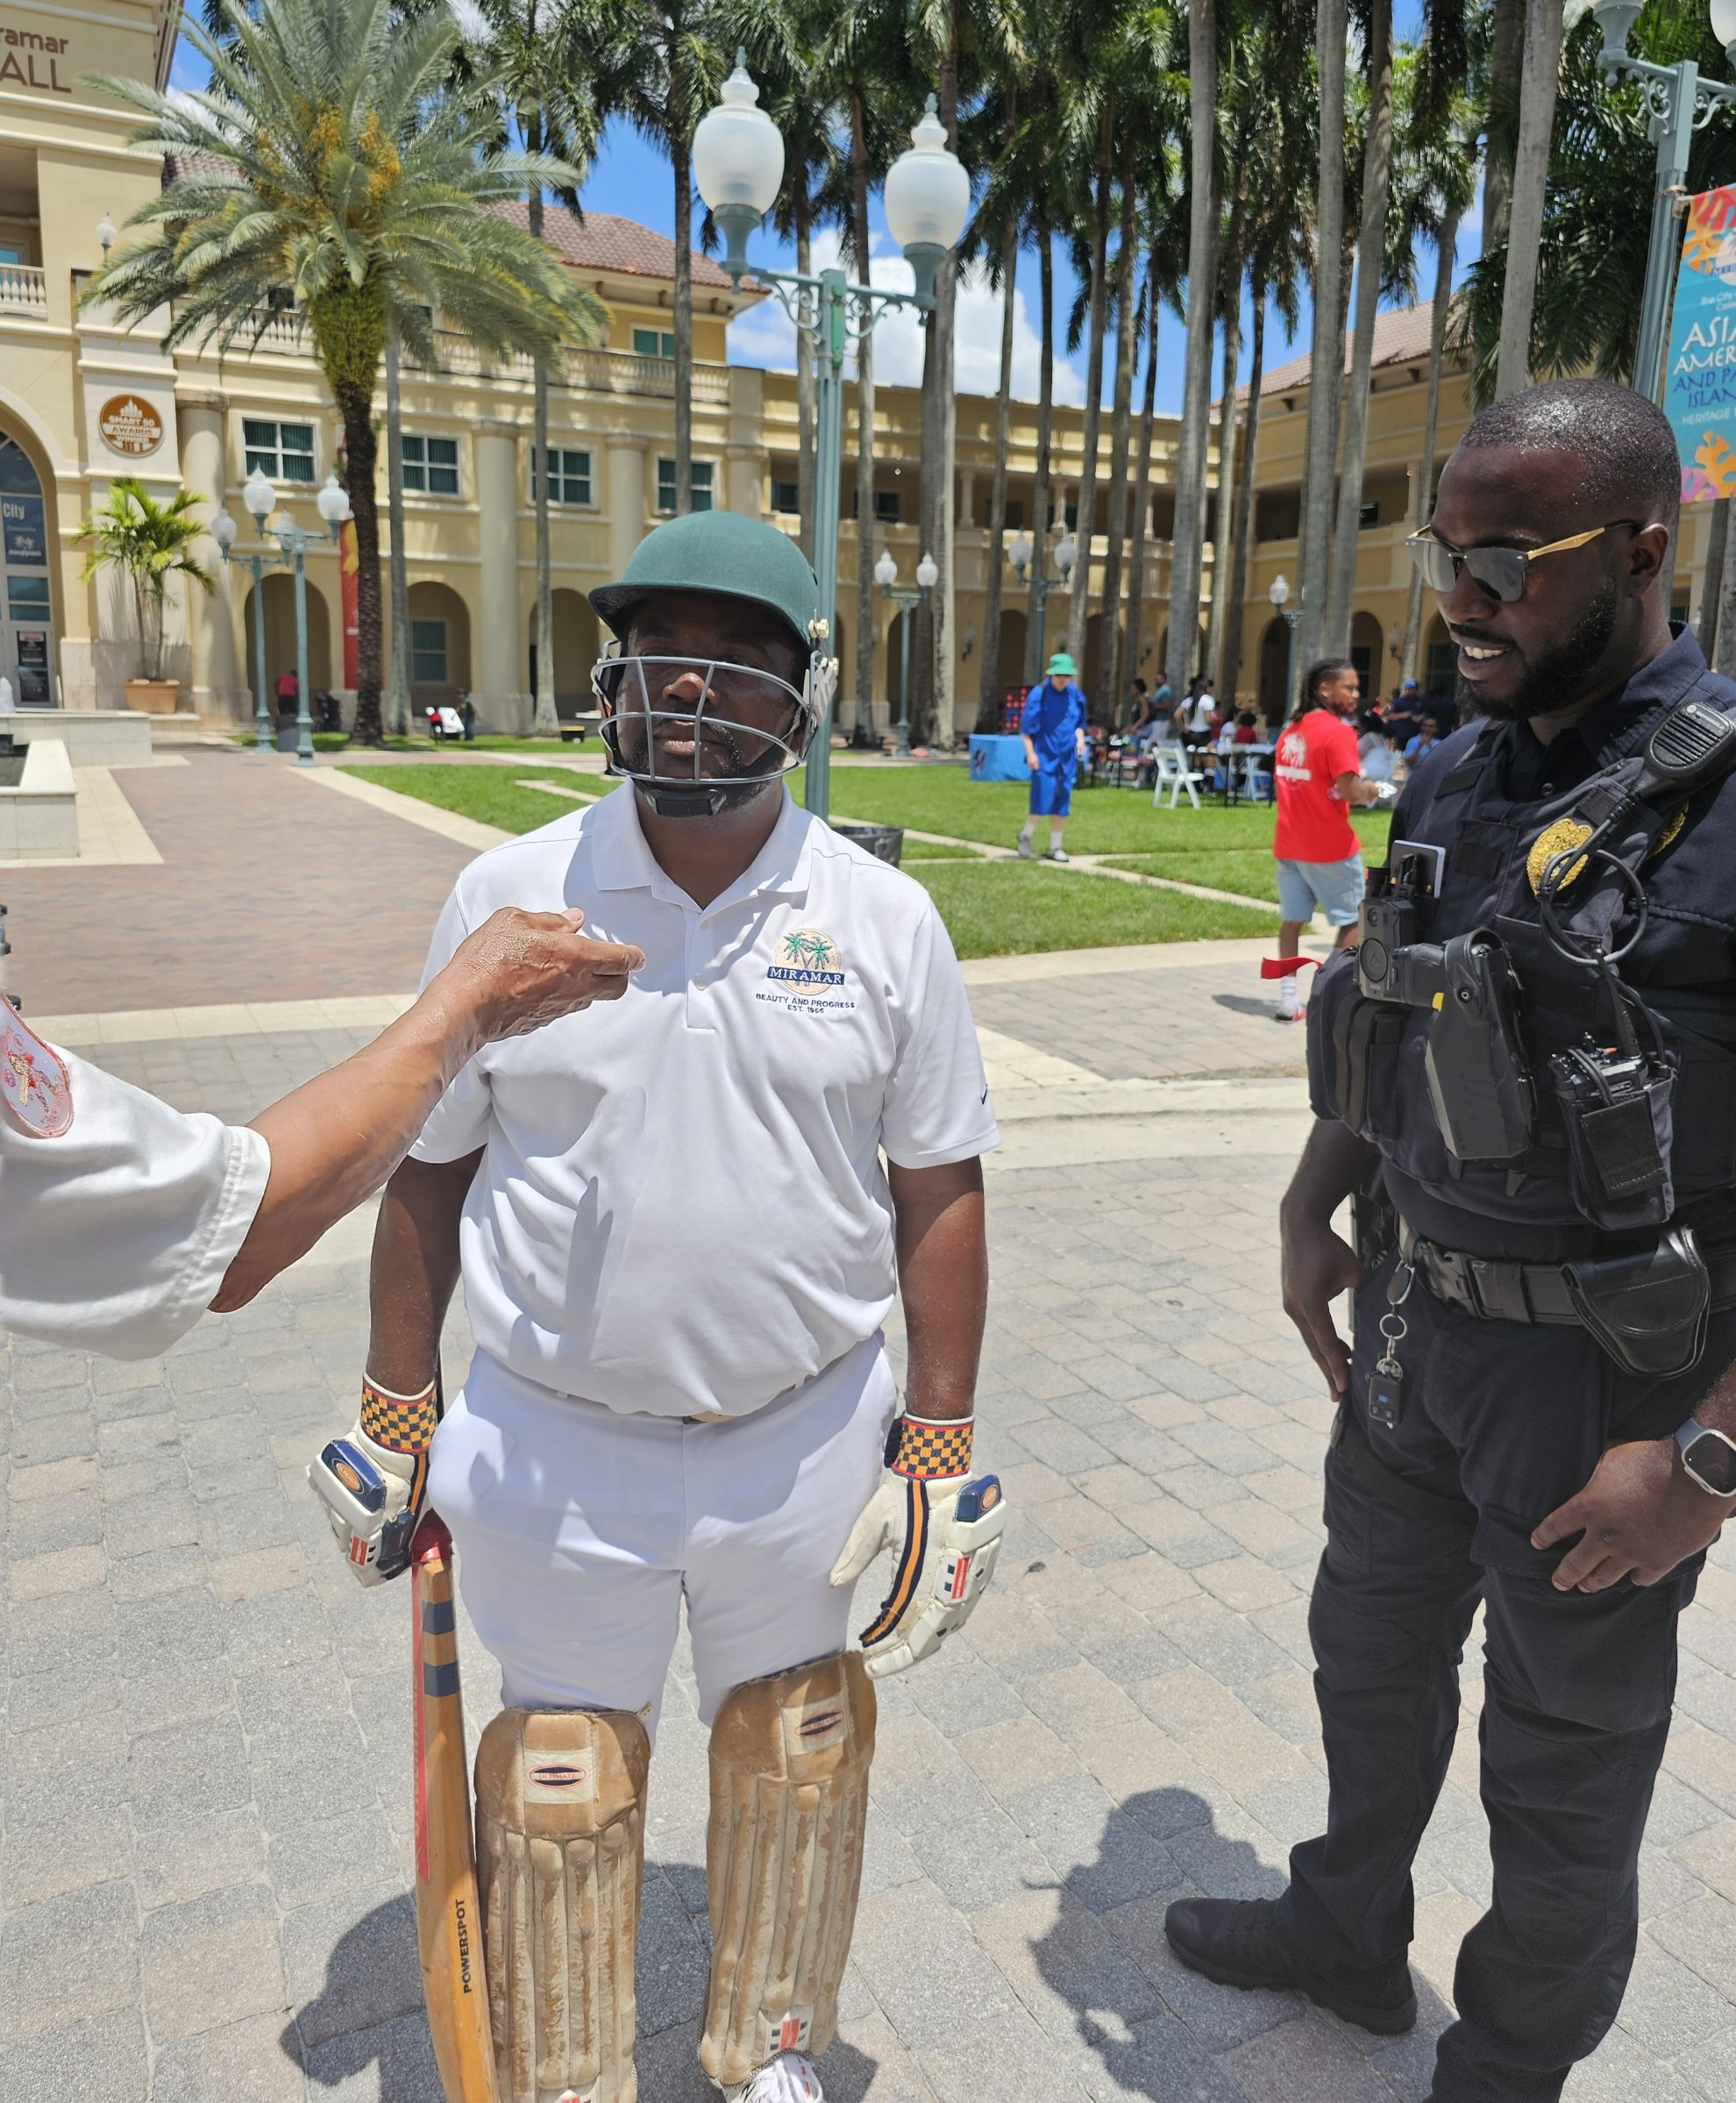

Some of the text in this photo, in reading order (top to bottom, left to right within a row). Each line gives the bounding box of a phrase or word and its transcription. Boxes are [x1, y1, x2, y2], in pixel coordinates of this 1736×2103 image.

[1672, 371, 1716, 393] AND
[1683, 407, 1730, 424] HERITAGE
[3, 503, 25, 520] City
[770, 967, 842, 984] MIRAMAR
[756, 993, 789, 1004] BEAUTY
[811, 999, 855, 1009] PROGRESS
[456, 1899, 472, 1994] POWERSPOT
